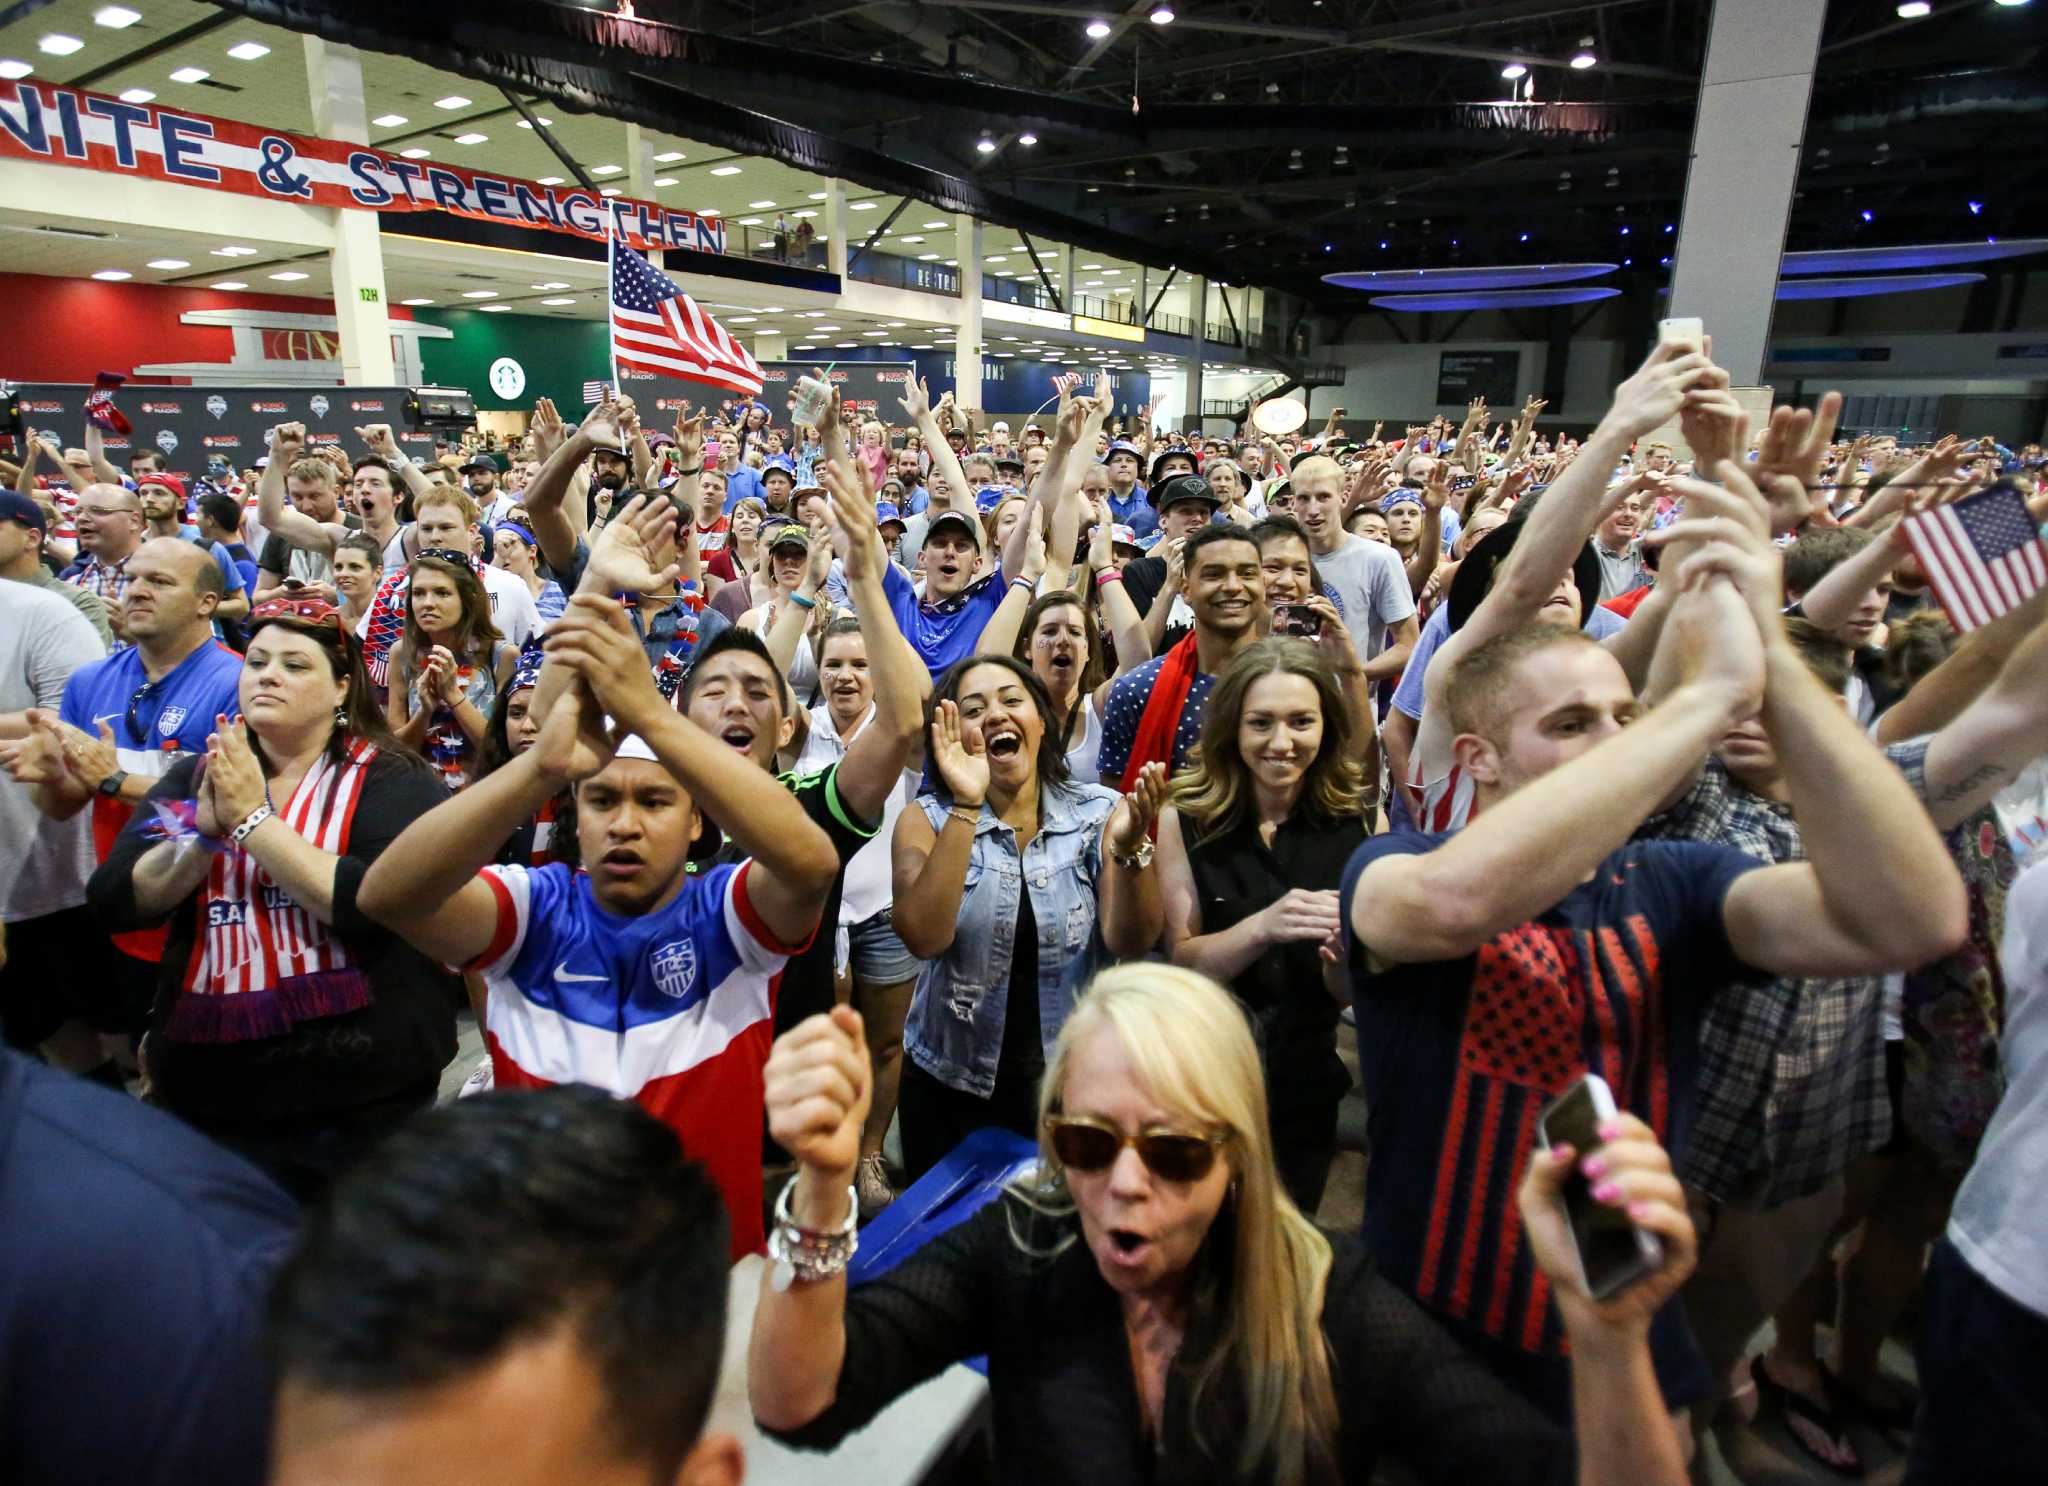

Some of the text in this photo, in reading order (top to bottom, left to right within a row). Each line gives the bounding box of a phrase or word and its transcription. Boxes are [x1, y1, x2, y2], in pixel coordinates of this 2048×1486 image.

[256, 136, 313, 199] &
[348, 152, 727, 254] STRENGTHEN
[360, 288, 378, 302] 12H
